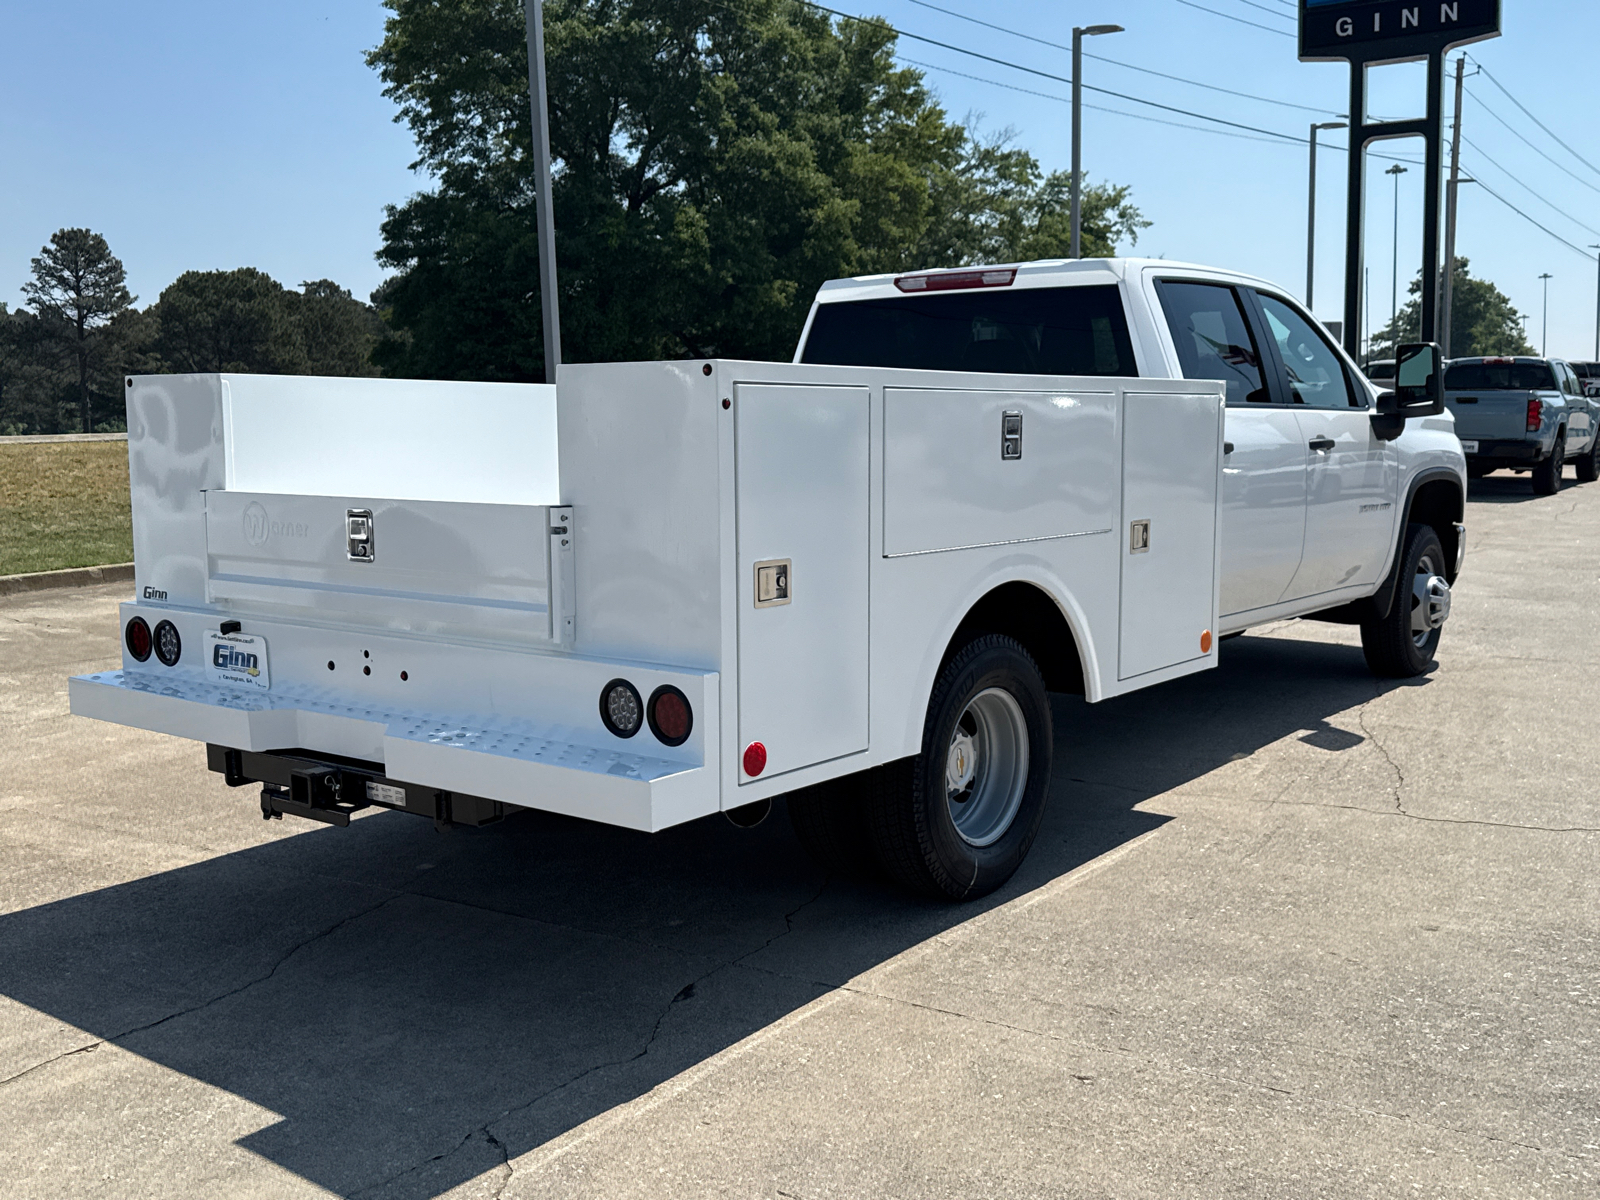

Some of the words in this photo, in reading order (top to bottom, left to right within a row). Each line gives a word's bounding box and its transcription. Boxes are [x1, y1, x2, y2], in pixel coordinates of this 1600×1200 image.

[1335, 2, 1458, 37] GINN
[143, 586, 168, 600] Ginn
[213, 643, 258, 669] Ginn
